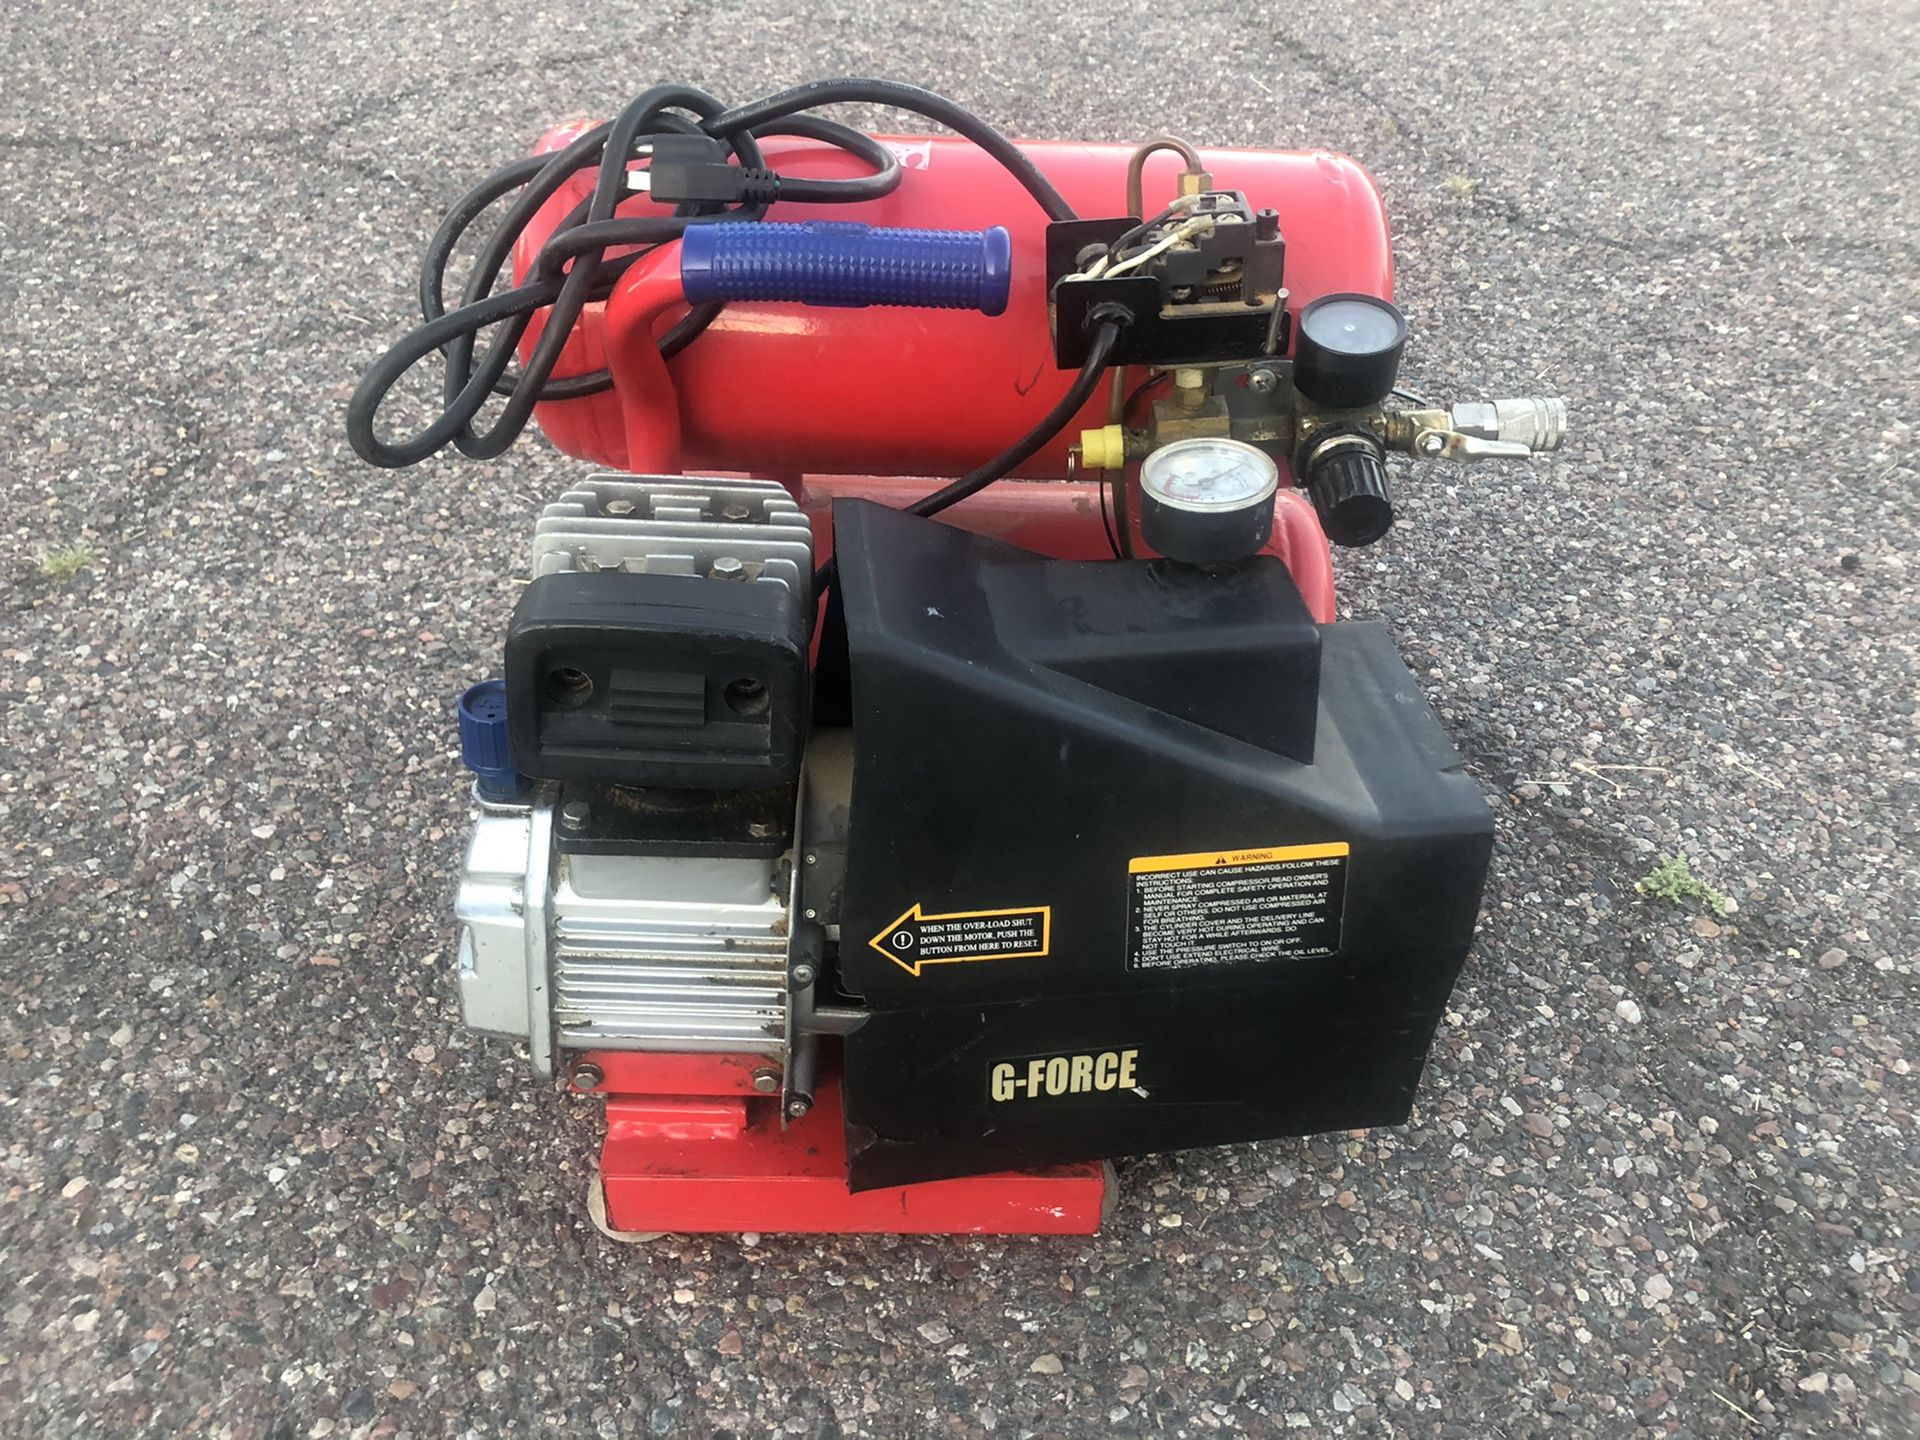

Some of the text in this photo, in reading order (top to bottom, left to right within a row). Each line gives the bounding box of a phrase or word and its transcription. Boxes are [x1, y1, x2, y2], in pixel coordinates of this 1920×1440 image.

[1231, 852, 1273, 862] WARNING
[1135, 871, 1181, 881] INCORRECT
[1182, 870, 1199, 878] USE
[1200, 868, 1217, 876] CAN
[1217, 866, 1244, 875] CAUSE
[1315, 859, 1340, 867] THESE
[1143, 885, 1175, 894] BEFORE
[1176, 882, 1215, 891] STARTING
[1271, 875, 1293, 883] READ
[1143, 879, 1329, 900] MANUAL FOR COMPLETE SAFETY OPERATION AND
[1143, 904, 1170, 913] NEVER
[1171, 902, 1197, 911] SPRAY
[1197, 898, 1252, 909] COMPRESSED
[1252, 896, 1266, 904] AIR
[1266, 895, 1278, 903] OR
[1279, 893, 1316, 902] MATERIAL
[1317, 891, 1329, 899] AT
[1143, 911, 1162, 919] SELF
[1163, 910, 1176, 918] OR
[1211, 906, 1224, 914] DO
[1224, 905, 1241, 913] NOT
[1241, 903, 1258, 911] USE
[1258, 900, 1312, 910] COMPRESSED
[920, 918, 1033, 934] WHEN THE OVER-LOAD SHUT
[1142, 918, 1160, 926] FOR
[1142, 929, 1176, 938] BECOME
[1176, 927, 1198, 935] VERY
[1215, 923, 1246, 932] DURING
[1246, 919, 1291, 930] OPERATING
[1291, 918, 1308, 926] AND
[1143, 924, 1159, 932] THE
[1159, 921, 1198, 930] CYLINDER
[1198, 918, 1226, 928] COVER
[1226, 917, 1243, 925] AND
[1244, 915, 1260, 923] THE
[1260, 912, 1298, 922] DELIVERY
[1298, 911, 1316, 919] LINE
[920, 935, 946, 945] DOWN
[946, 933, 963, 942] THE
[996, 930, 1018, 939] PUSH
[1019, 928, 1035, 937] THE
[1142, 943, 1159, 951] NOT
[1160, 940, 1187, 949] TOUCH
[1163, 934, 1180, 942] HOT
[1181, 933, 1198, 941] FOR
[1198, 932, 1205, 940] A
[1205, 930, 1230, 939] WHILE
[920, 945, 953, 956] BUTTON
[954, 943, 977, 953] FROM
[978, 941, 1000, 951] HERE
[1001, 940, 1013, 949] TO
[1141, 949, 1159, 957] USE
[1159, 947, 1175, 955] THE
[1175, 944, 1217, 954] PRESSURE
[1217, 941, 1248, 951] SWITCH
[1248, 940, 1260, 948] TO
[1260, 938, 1273, 947] ON
[1165, 953, 1182, 961] USE
[1182, 950, 1214, 959] EXTEND
[1214, 947, 1260, 957] ELECTRICAL
[1141, 960, 1173, 969] BEFORE
[1249, 951, 1277, 960] CHECK
[1278, 949, 1292, 957] THE
[1293, 948, 1306, 956] OIL
[991, 1049, 1138, 1102] G-FORCE
